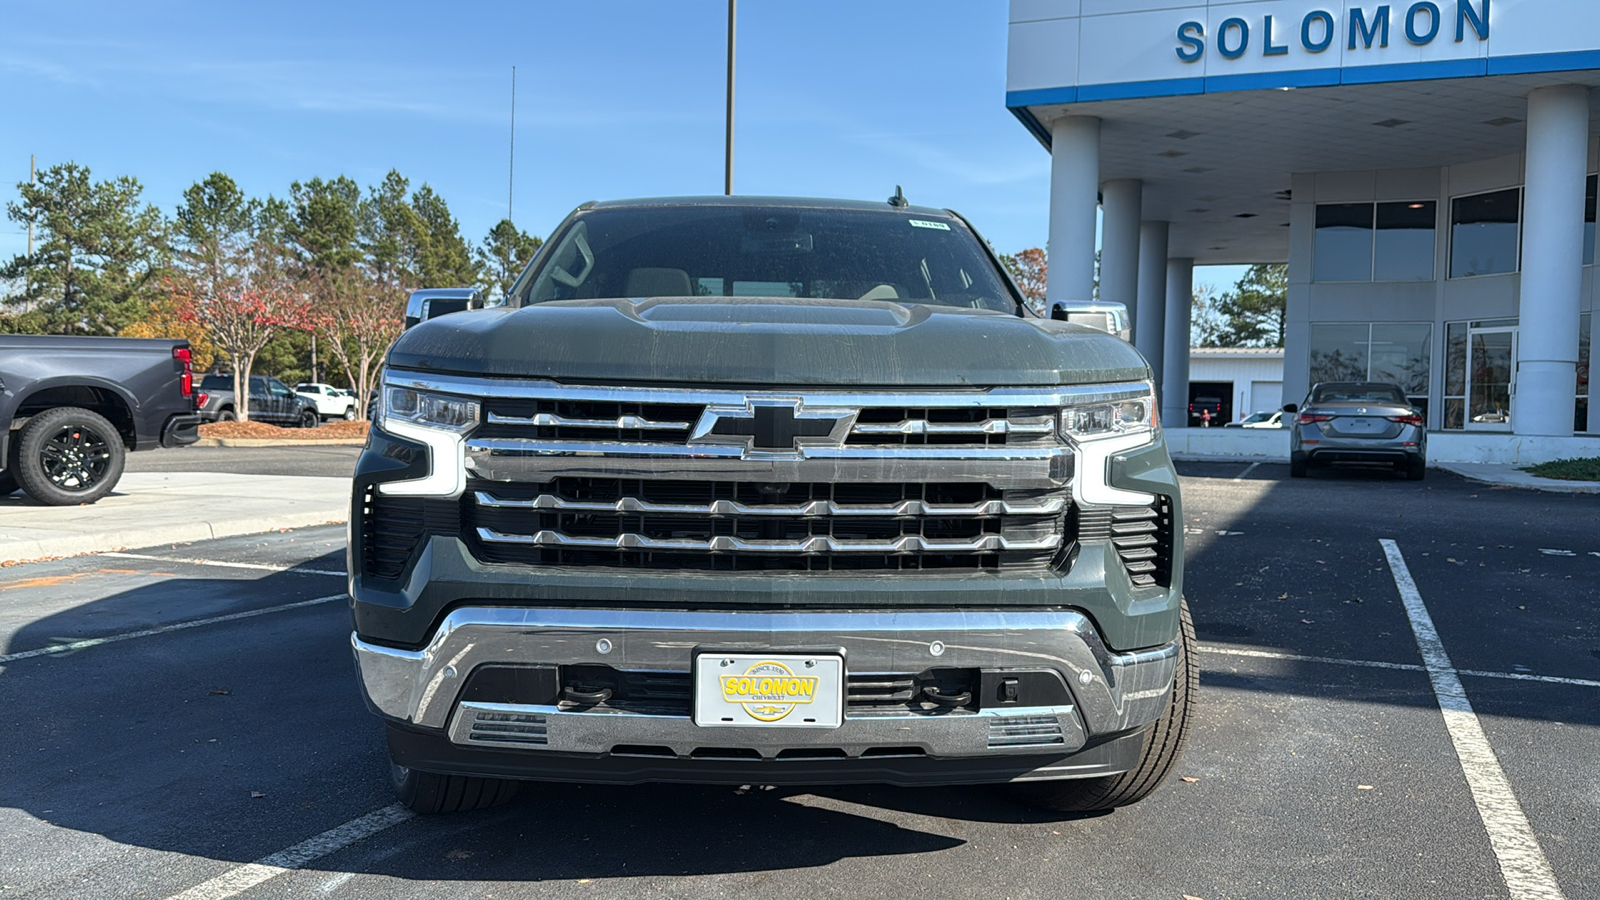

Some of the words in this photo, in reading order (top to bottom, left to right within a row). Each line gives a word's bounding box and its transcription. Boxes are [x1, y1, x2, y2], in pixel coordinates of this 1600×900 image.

[1175, 0, 1489, 62] SOLOMON
[752, 665, 770, 675] SINCE
[725, 677, 813, 696] SOLOMON
